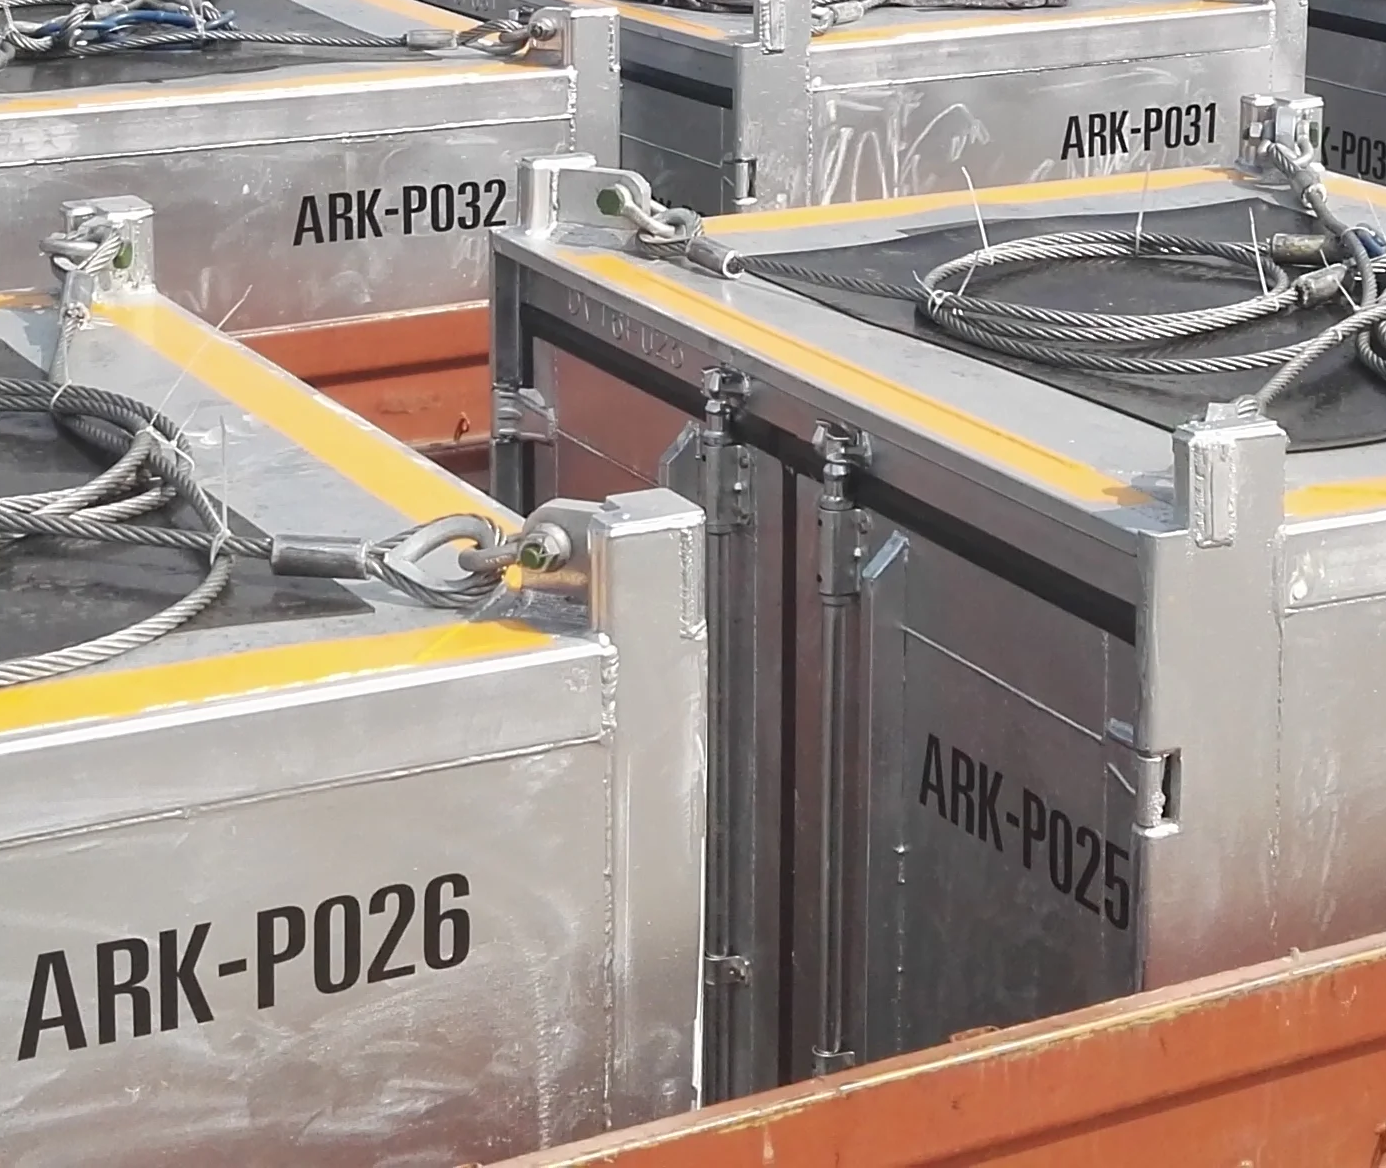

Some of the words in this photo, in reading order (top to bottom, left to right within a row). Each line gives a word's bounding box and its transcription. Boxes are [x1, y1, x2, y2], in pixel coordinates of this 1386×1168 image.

[1061, 102, 1216, 160] ARK-P031
[293, 179, 507, 246] ARK-P032
[919, 733, 1130, 930] ARK-P025
[17, 873, 471, 1061] ARK-P026
